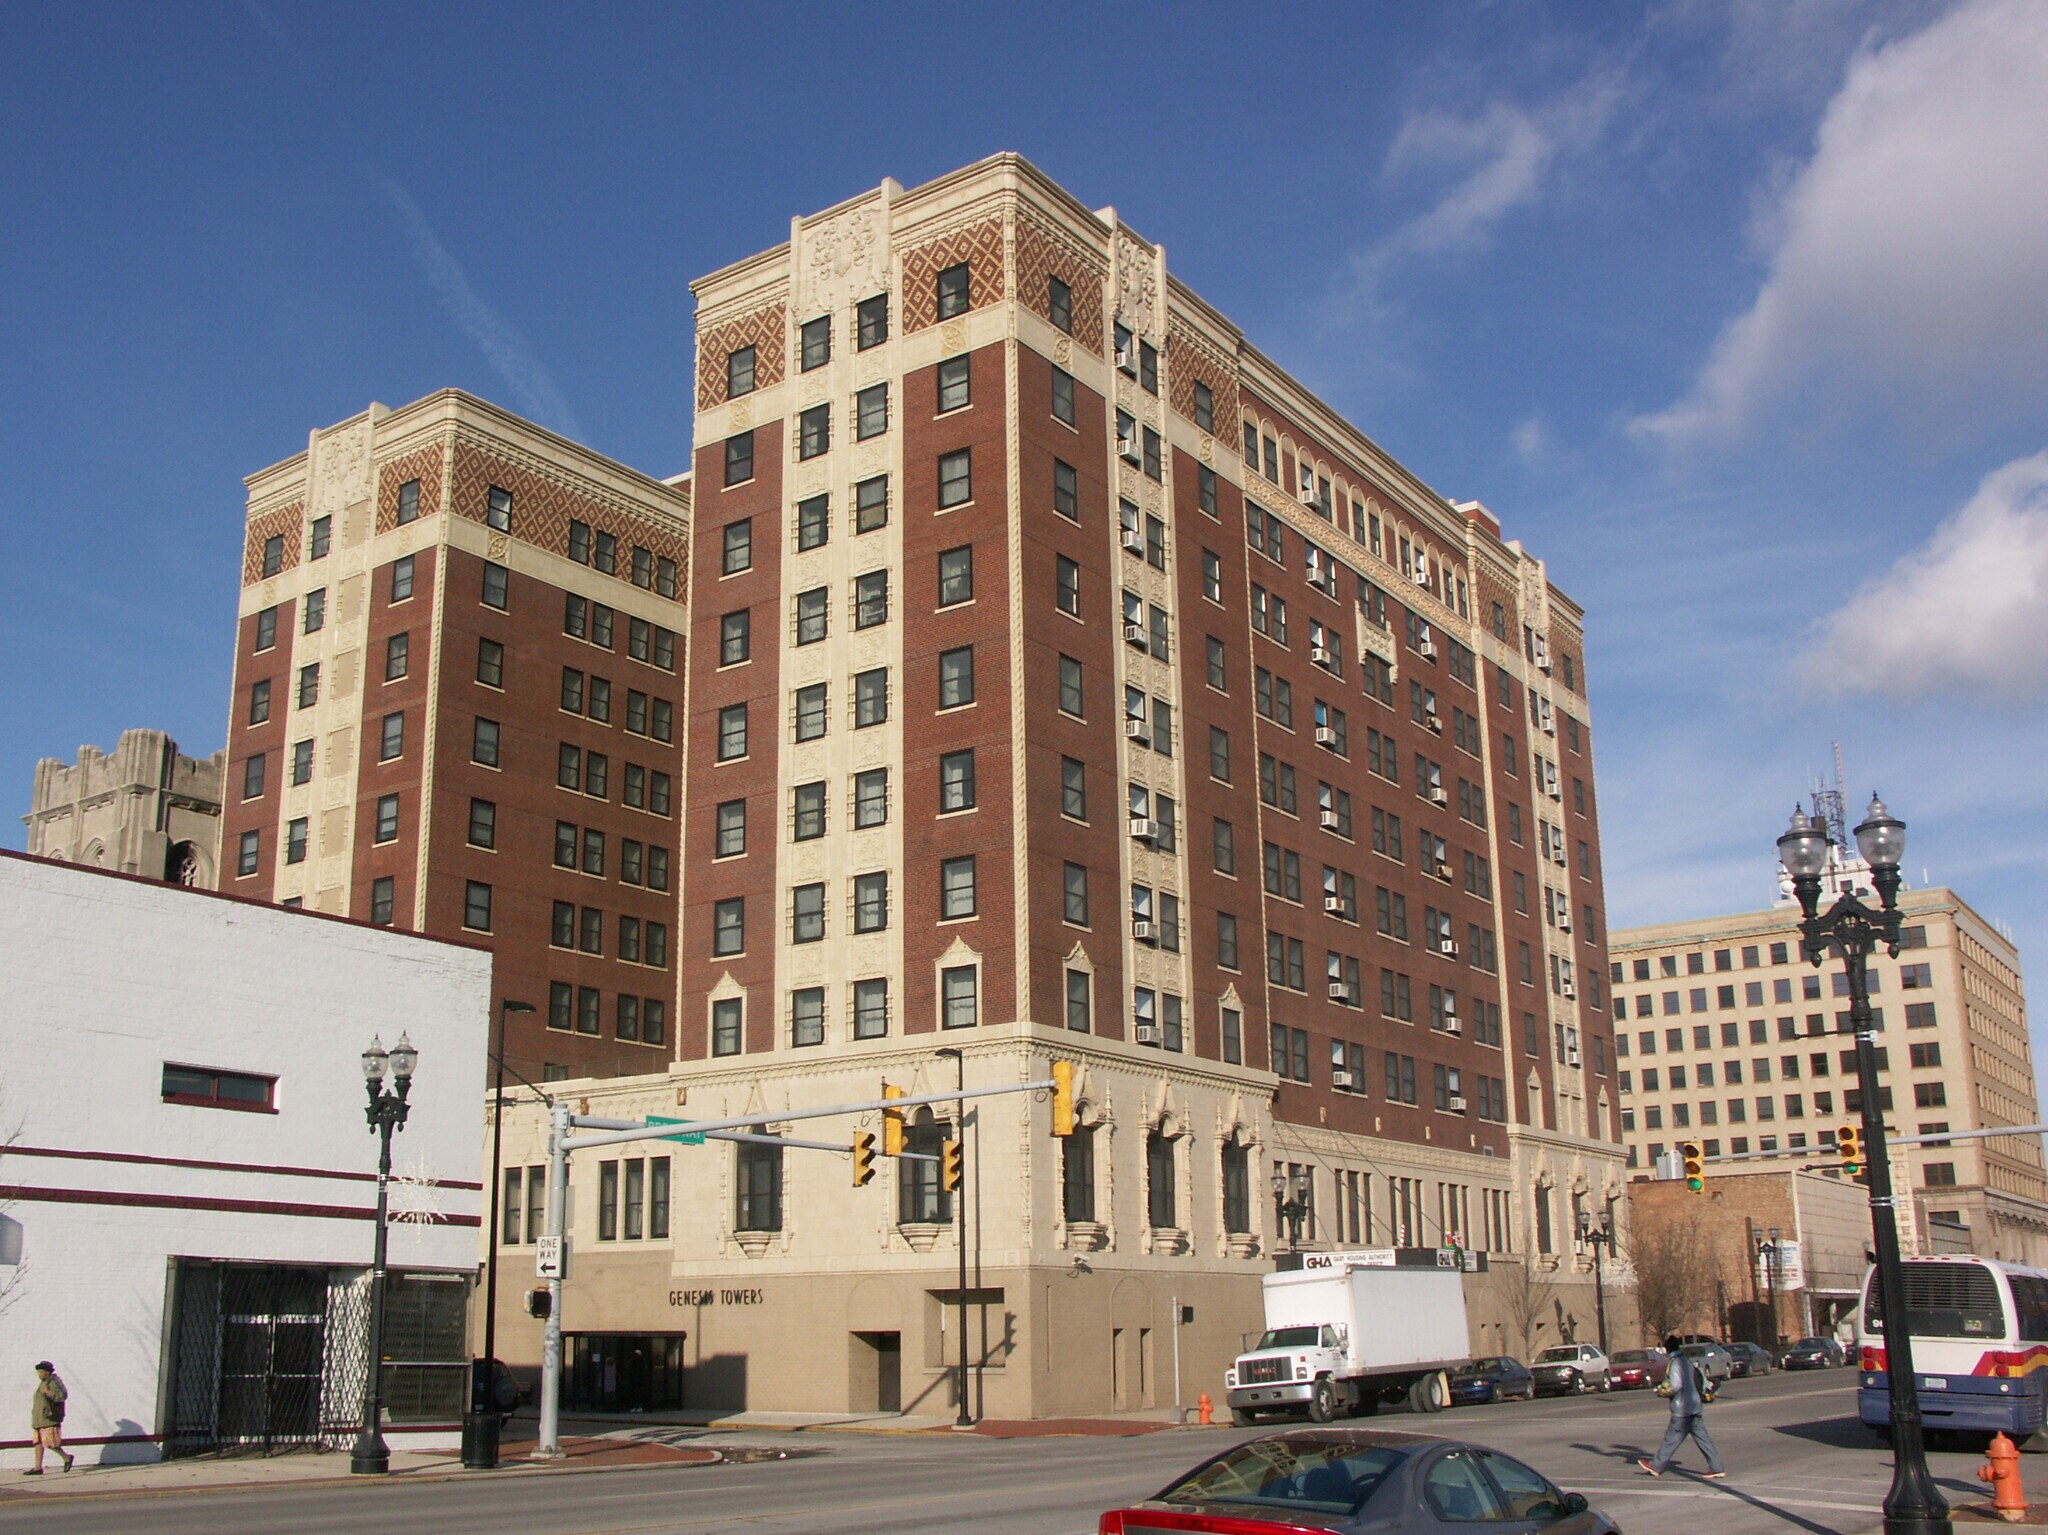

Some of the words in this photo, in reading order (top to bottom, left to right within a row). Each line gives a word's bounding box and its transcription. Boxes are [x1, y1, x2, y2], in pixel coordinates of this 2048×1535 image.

[648, 1121, 700, 1138] BRAY
[540, 1238, 557, 1248] ONE
[539, 1250, 557, 1259] WAY
[1306, 1256, 1332, 1268] GHA
[669, 1290, 714, 1306] GENESIS
[720, 1288, 763, 1305] TOWERS
